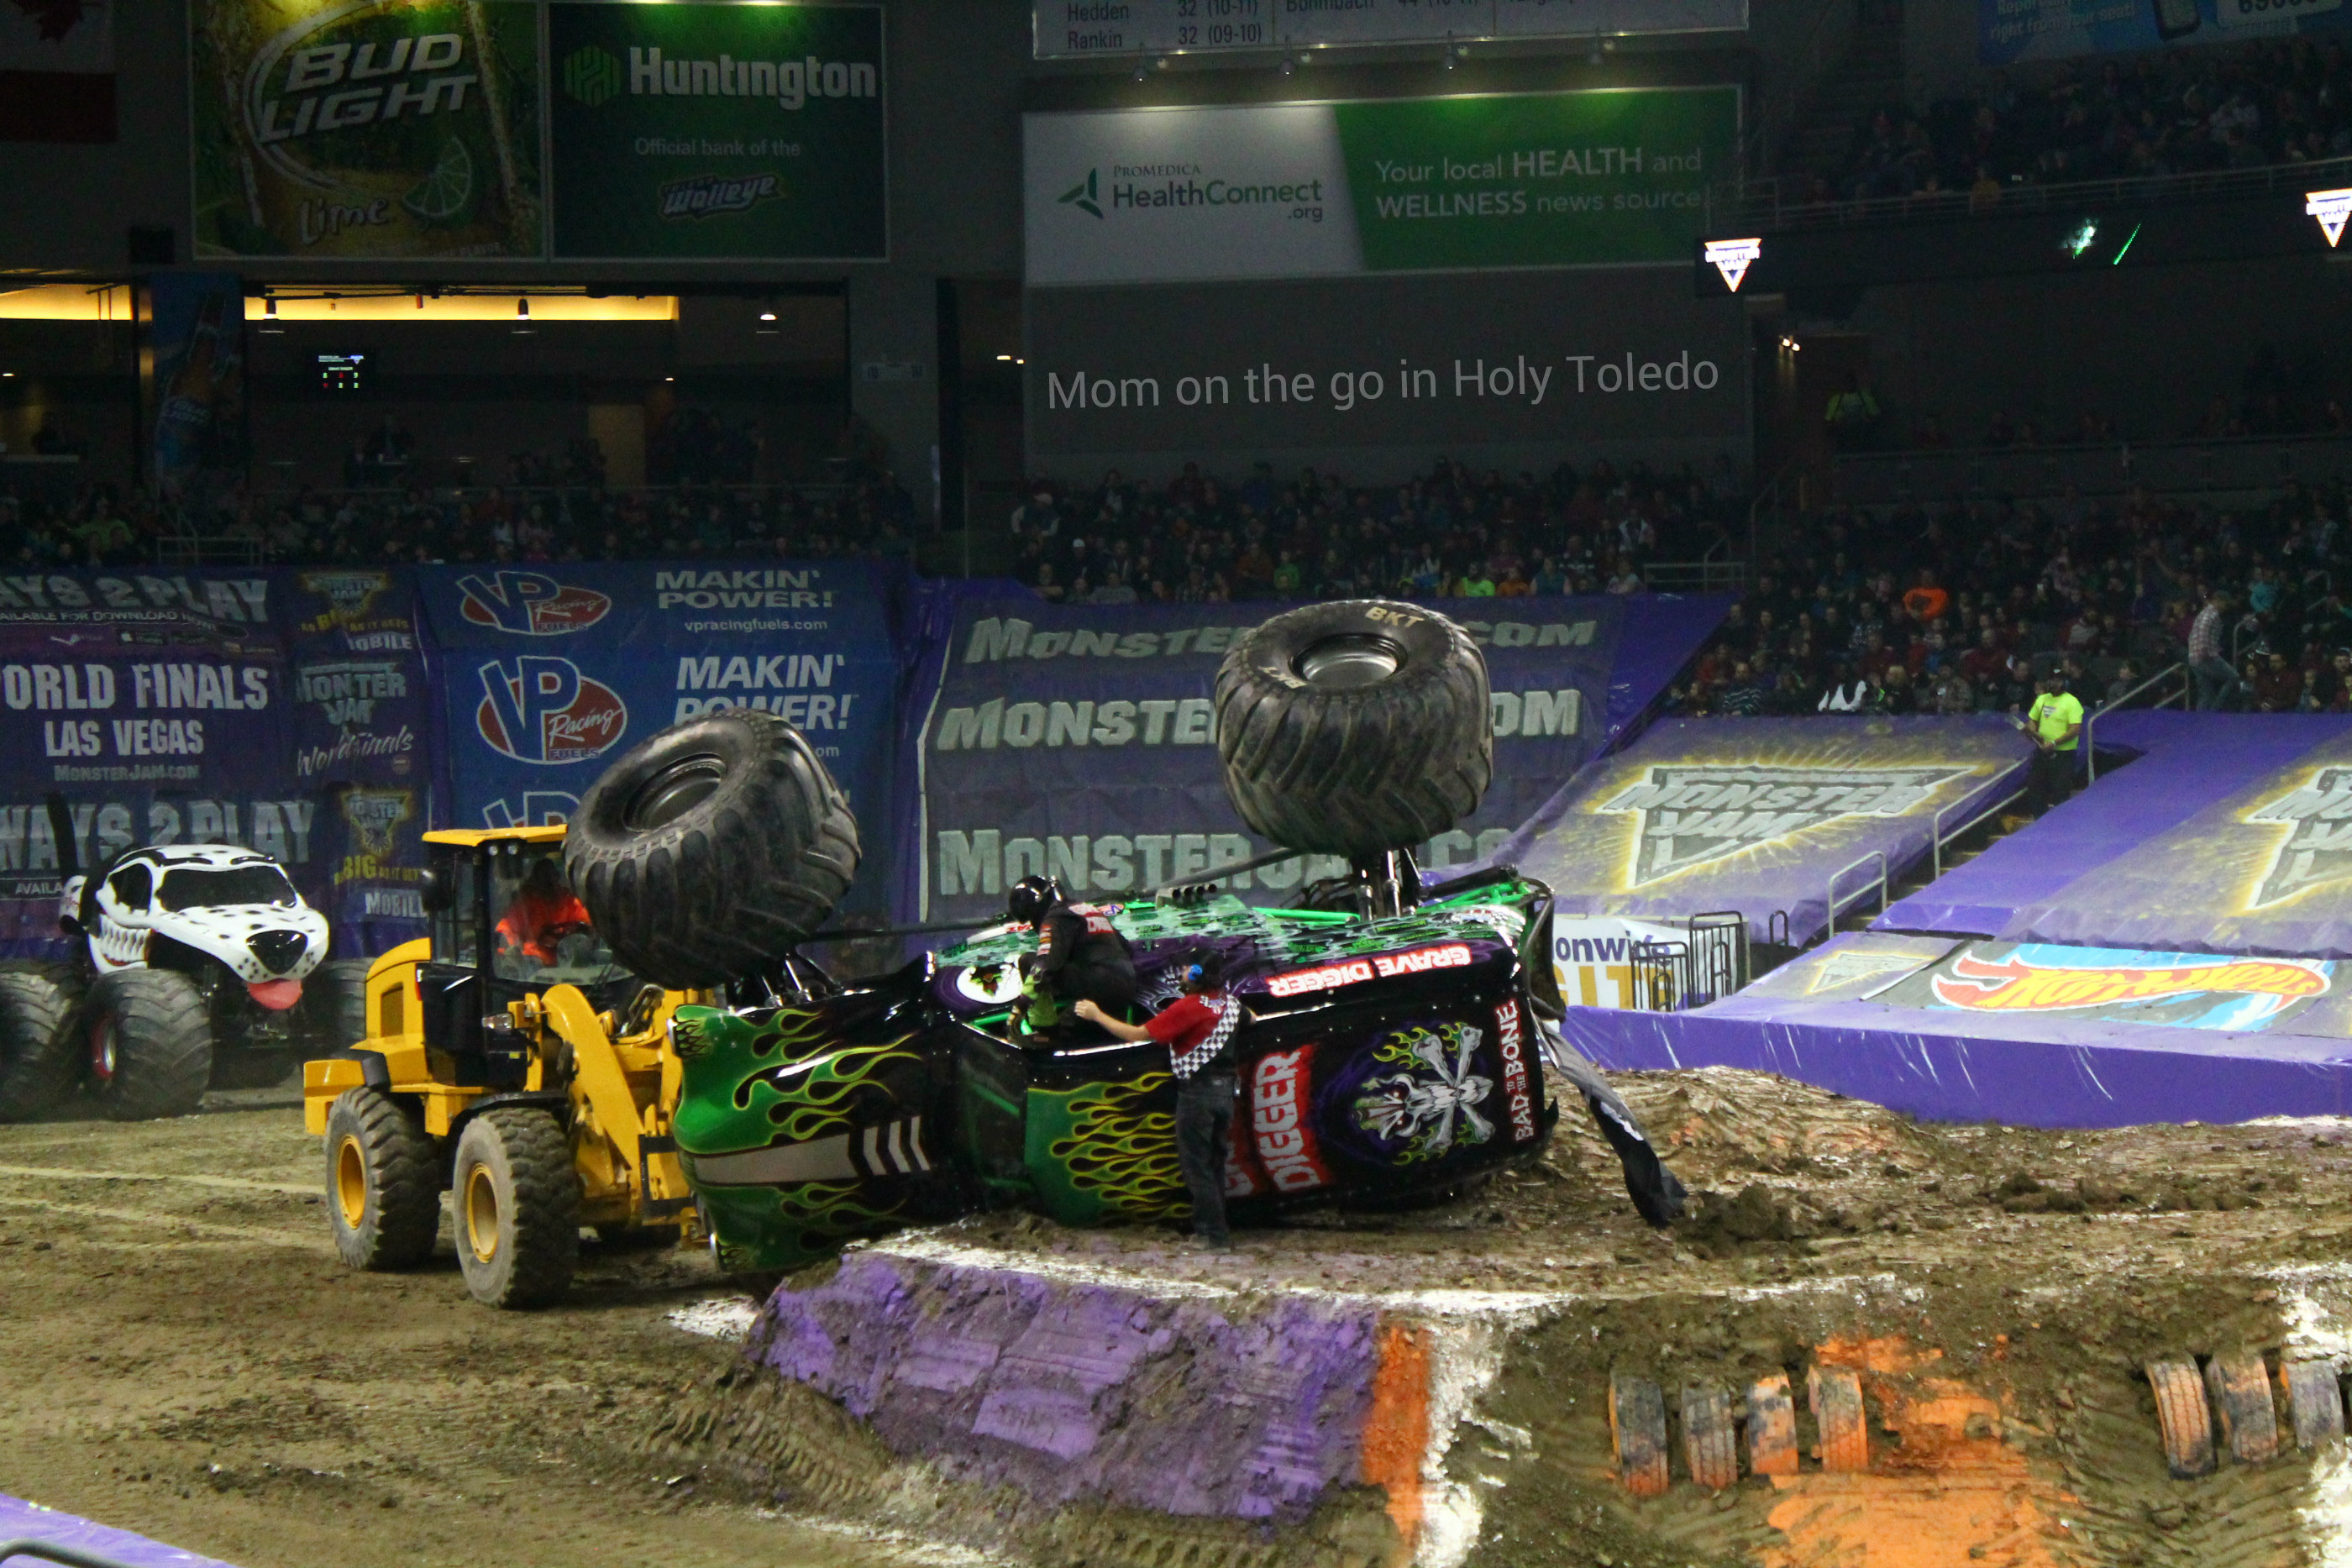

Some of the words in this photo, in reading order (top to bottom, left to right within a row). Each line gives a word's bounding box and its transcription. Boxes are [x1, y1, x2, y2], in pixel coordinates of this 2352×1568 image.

[1068, 3, 1129, 22] Hedden
[1179, 0, 1198, 17] 32
[1068, 31, 1123, 50] Rankin
[1179, 26, 1198, 45] 32
[1209, 24, 1262, 46] (09-10)
[286, 33, 463, 92] BUD
[630, 47, 876, 110] Huntington
[258, 75, 477, 144] LIGHT
[635, 138, 696, 157] Official
[701, 139, 744, 157] bank
[750, 139, 769, 157] of
[772, 139, 801, 158] the
[1113, 164, 1201, 178] PROMEDICA
[1375, 160, 1432, 183] Your
[1444, 155, 1503, 181] local
[1514, 147, 1642, 178] HEALTH
[1653, 147, 1702, 171] and
[664, 176, 775, 214] Walleye
[1113, 179, 1323, 208] HealthConnect
[1375, 191, 1527, 218] WELLNESS
[1537, 193, 1604, 212] news
[300, 197, 389, 245] Lime
[655, 570, 820, 590] MAKIN'
[455, 570, 561, 635] VP
[659, 590, 832, 609] POWER!
[60, 612, 89, 621] FOR
[92, 611, 178, 621] DOWNLOAD
[685, 618, 828, 633] vpracingfuels.com
[1365, 606, 1425, 628] BKT
[345, 633, 413, 652] OBILE
[2, 663, 117, 710] ORLD
[132, 663, 269, 710] FINALS
[676, 654, 845, 690] MAKIN'
[477, 654, 581, 764] VP
[45, 720, 102, 757] LAS
[112, 718, 205, 756] VEGAS
[549, 708, 617, 747] Racing
[548, 748, 600, 759] FUELS
[1602, 784, 1929, 813] MONSTER
[1648, 810, 1813, 838] JAM
[343, 855, 377, 879] BIG
[1376, 947, 1472, 978] GRAVE
[1268, 963, 1375, 997] DIGGER
[1495, 1000, 1525, 1078] BONE
[1254, 1051, 1323, 1192] DIGGER
[1511, 1093, 1535, 1142] BAD
